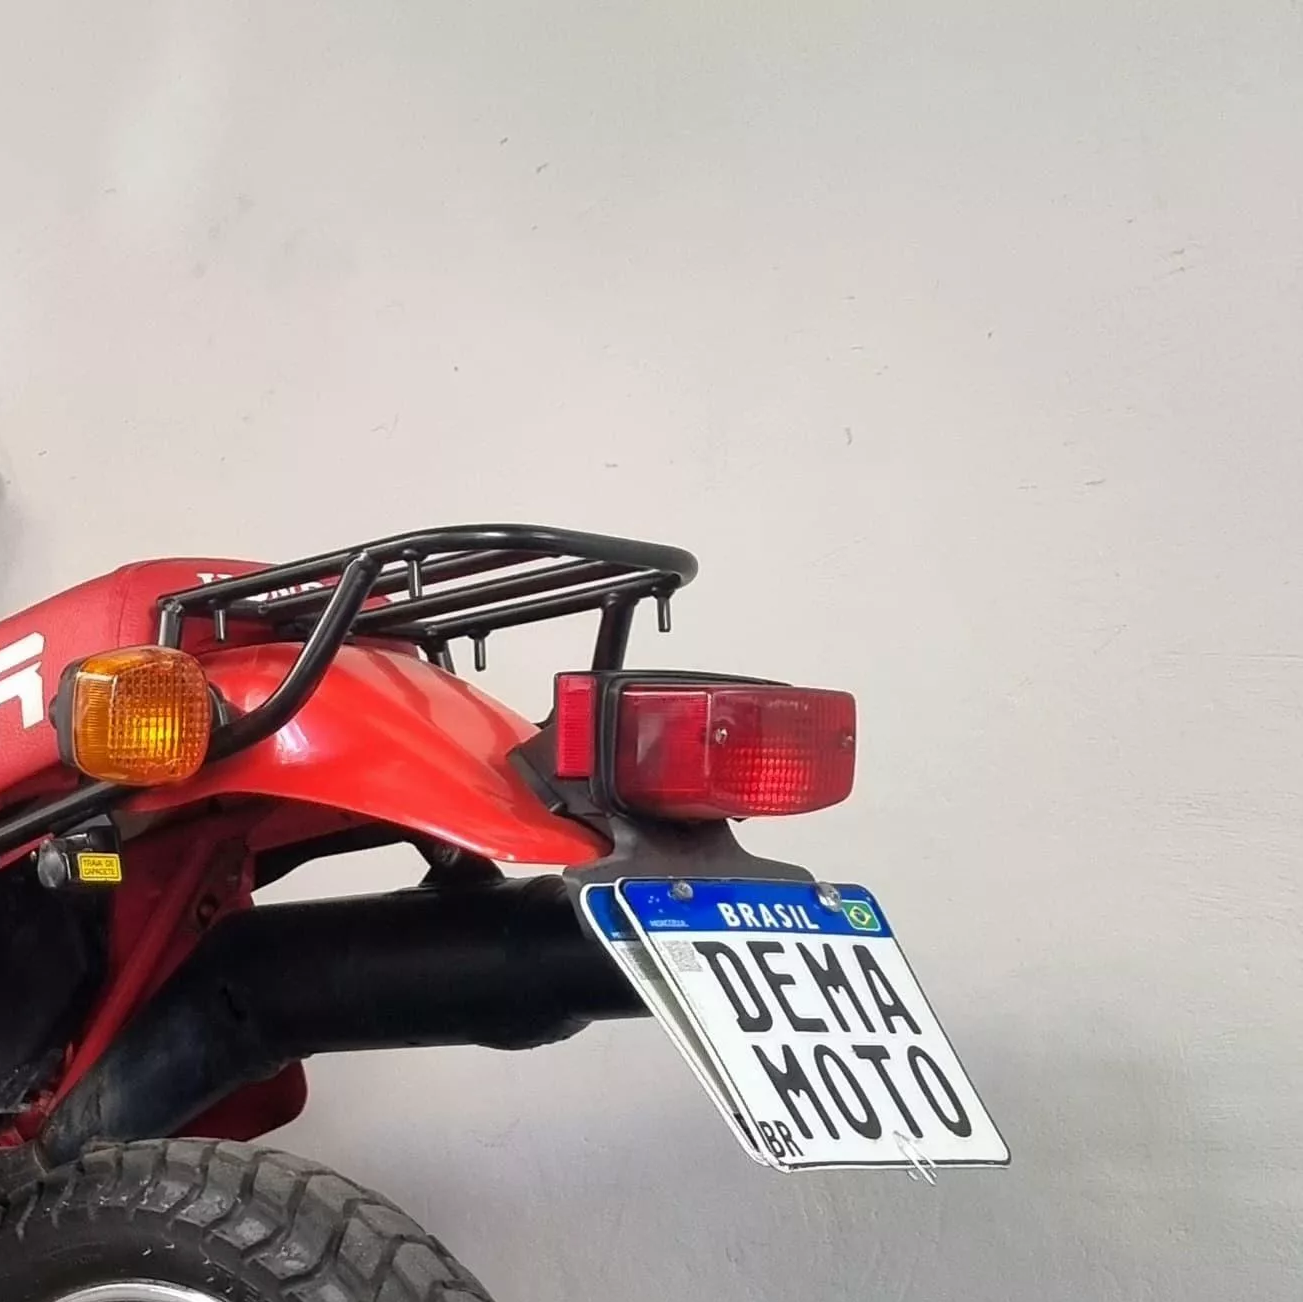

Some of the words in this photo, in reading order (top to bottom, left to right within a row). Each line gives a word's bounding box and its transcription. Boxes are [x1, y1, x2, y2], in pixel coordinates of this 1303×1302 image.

[716, 902, 821, 931] BRASIL
[696, 941, 923, 1036] DEMA
[752, 1044, 974, 1140] MOTO
[757, 1119, 805, 1158] BR
